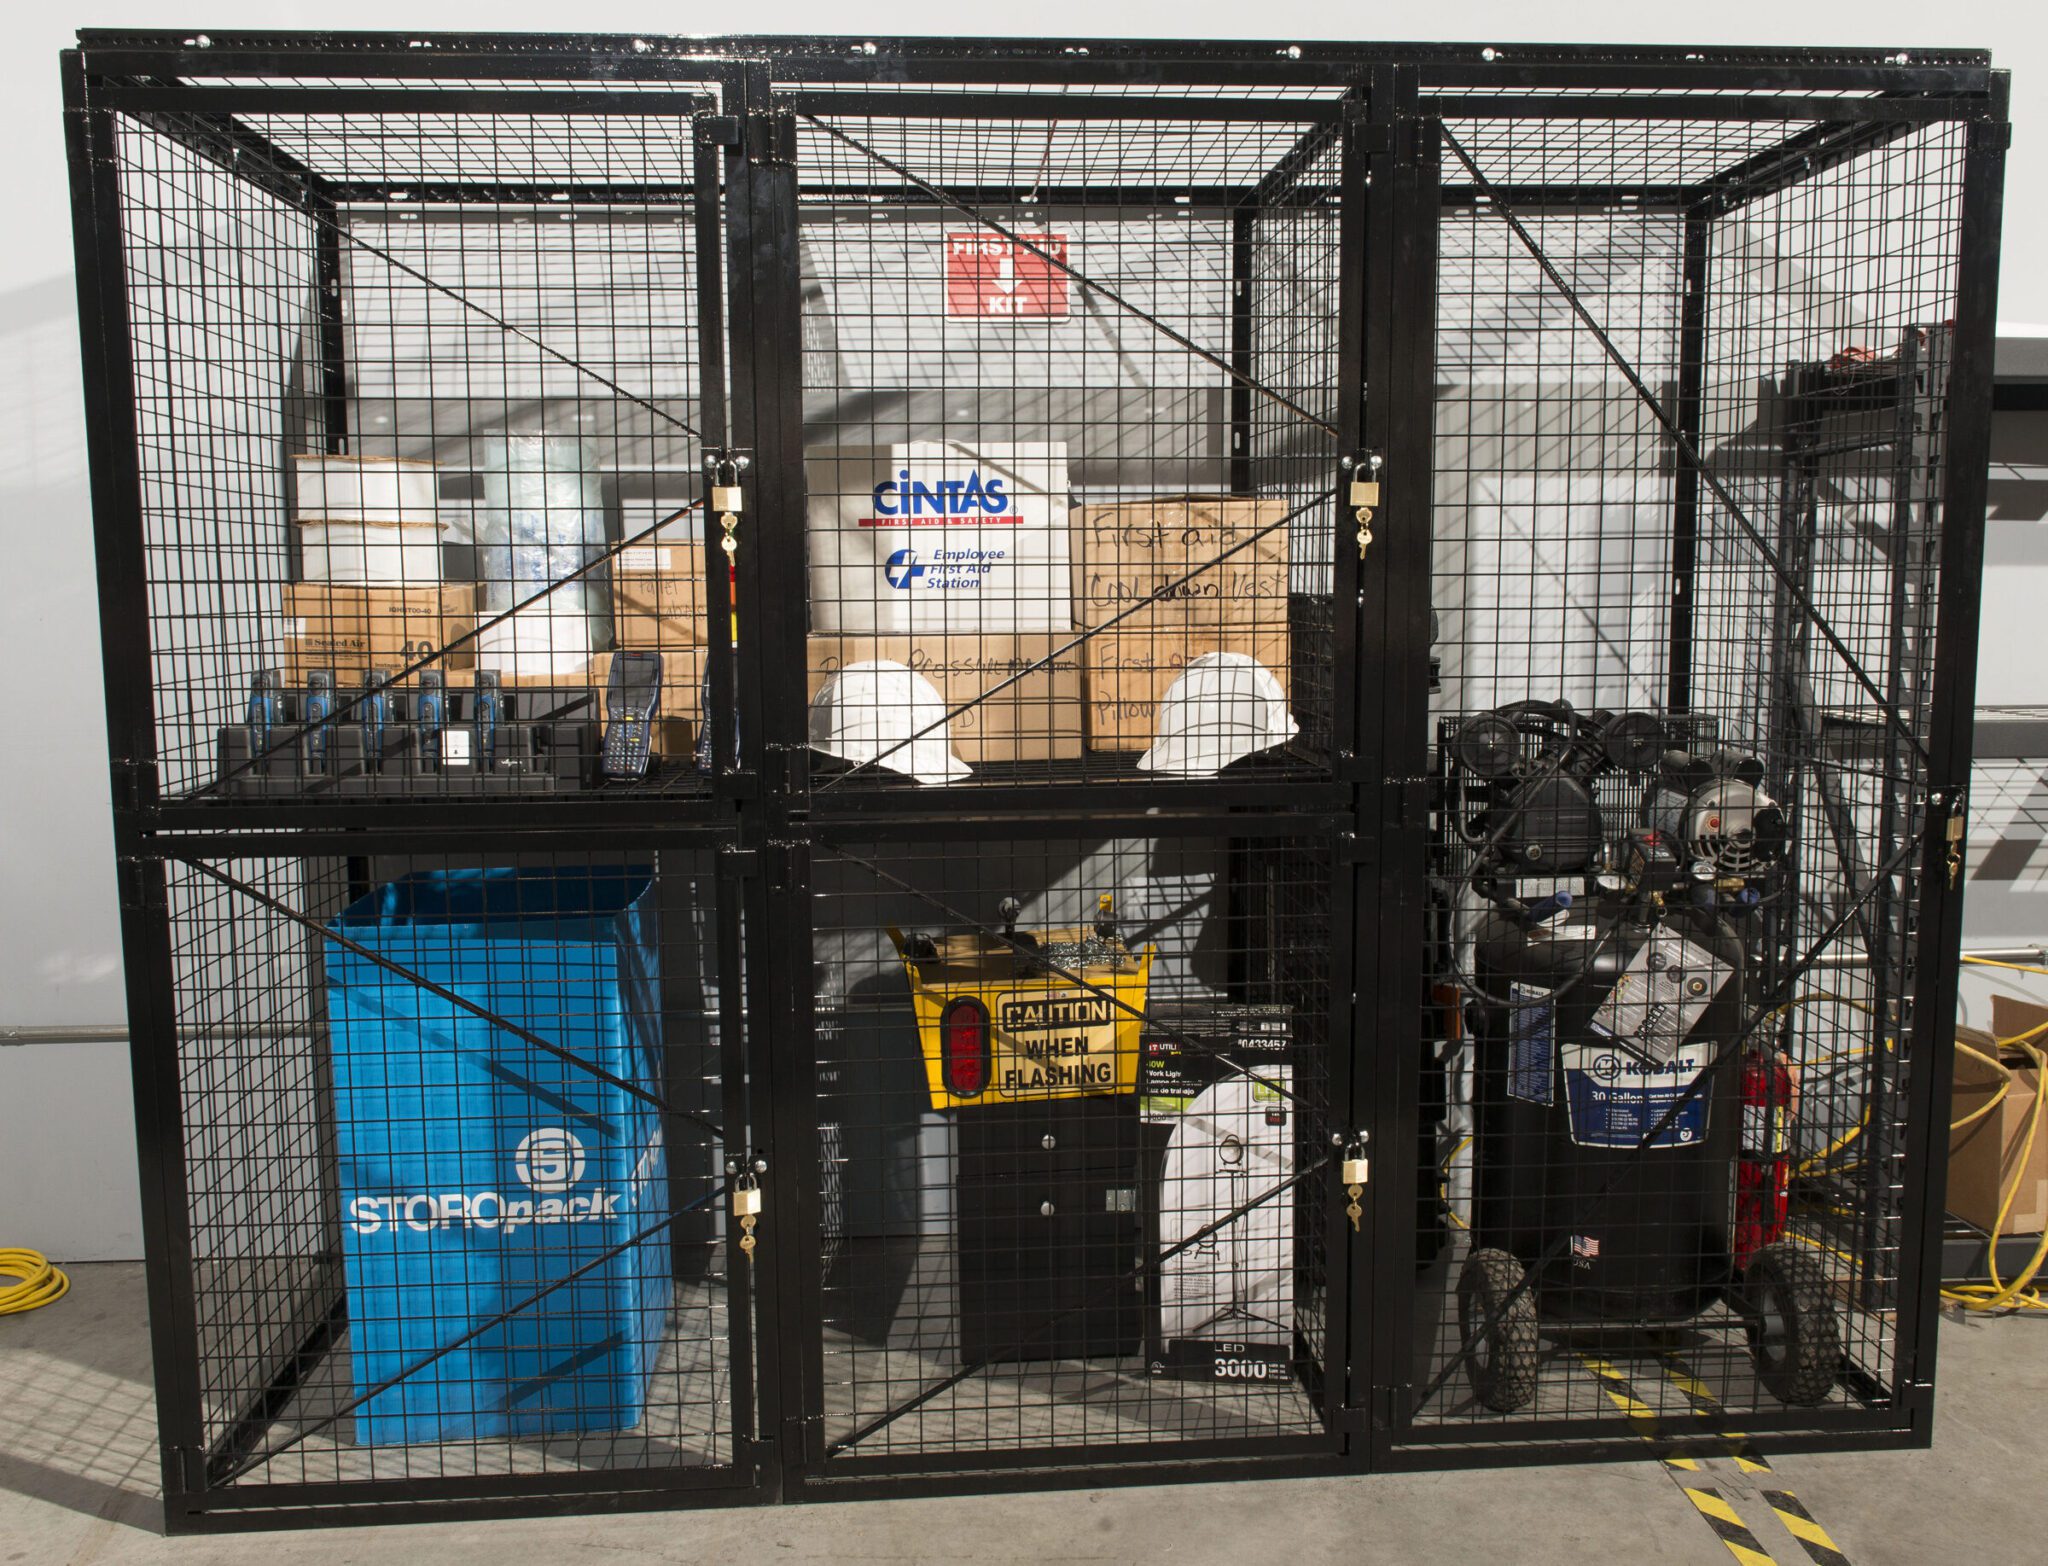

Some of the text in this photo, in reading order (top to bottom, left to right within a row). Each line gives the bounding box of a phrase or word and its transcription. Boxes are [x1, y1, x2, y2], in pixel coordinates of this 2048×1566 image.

[952, 238, 1061, 256] FIRST AID
[989, 296, 1027, 314] KIT
[1092, 512, 1237, 549] First aid
[934, 549, 1005, 565] Employee
[930, 562, 991, 575] First Aid
[927, 577, 980, 589] Station
[1232, 570, 1288, 602] Vest
[314, 639, 366, 648] Sealed Air
[400, 640, 433, 662] 40
[1100, 643, 1155, 680] First
[1006, 1001, 1107, 1028] CAUTION
[1026, 1036, 1088, 1059] WHEN
[1005, 1062, 1111, 1089] FLASHING
[1592, 1091, 1643, 1104] 30 Gallon
[350, 1187, 621, 1234] STOROpack
[1215, 1343, 1245, 1353] LED
[1215, 1358, 1267, 1379] 3000
